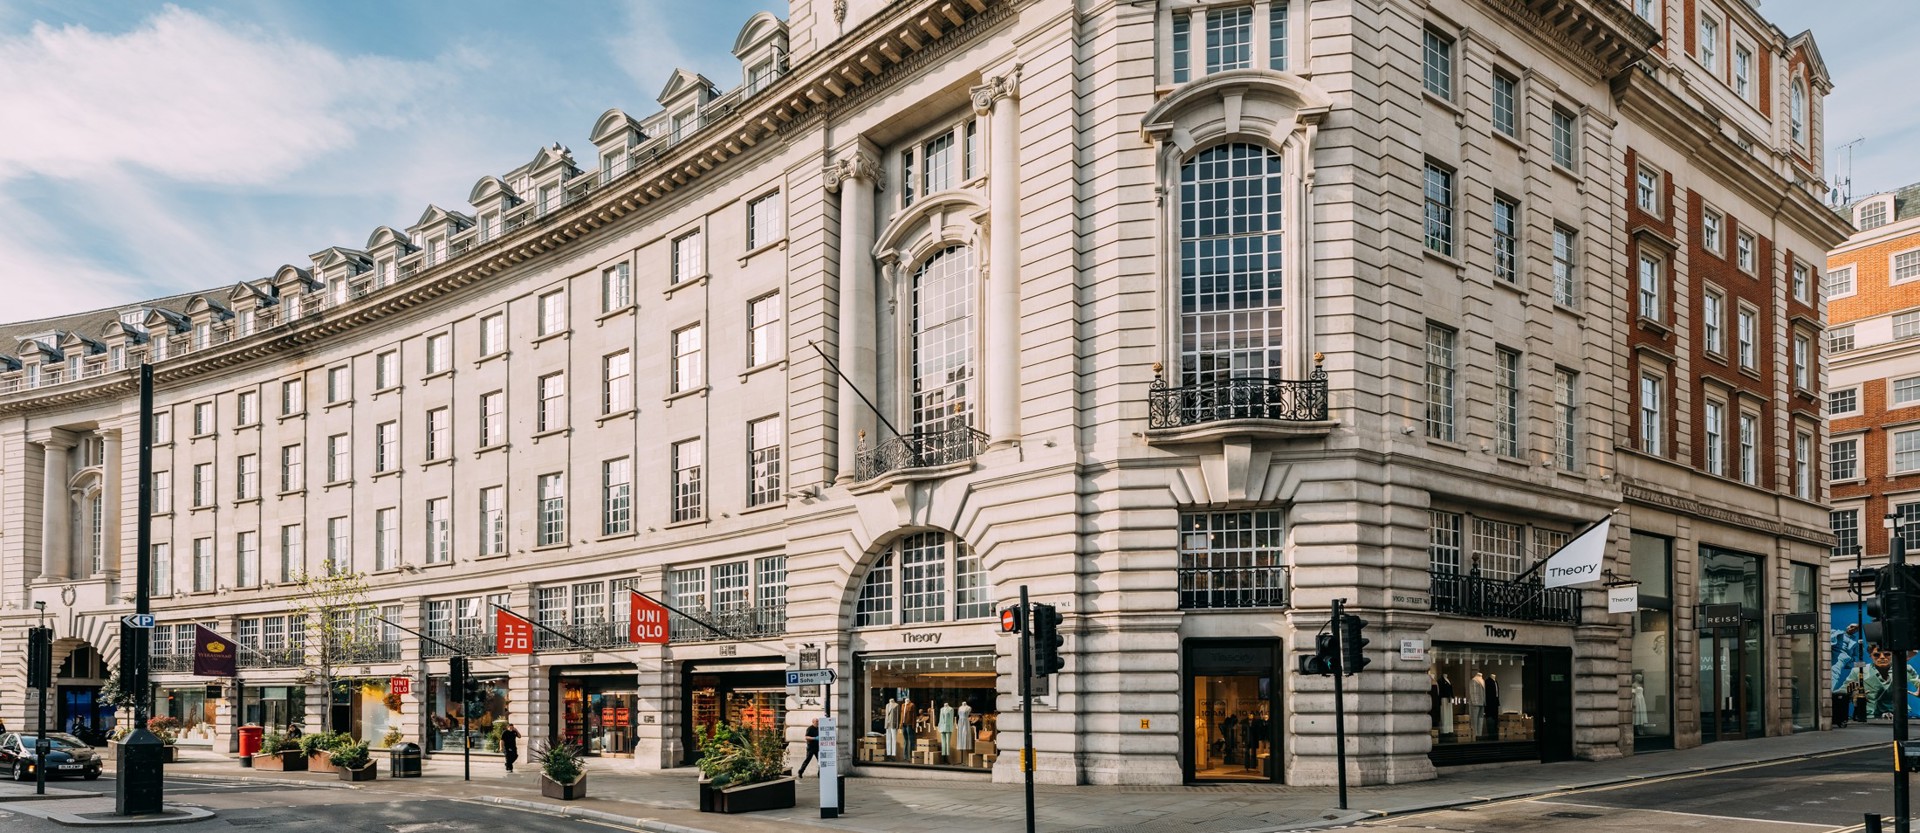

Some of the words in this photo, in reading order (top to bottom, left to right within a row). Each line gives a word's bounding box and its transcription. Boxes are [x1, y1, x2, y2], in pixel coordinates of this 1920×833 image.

[1549, 563, 1598, 578] Theory
[1392, 595, 1404, 603] VIGO
[1406, 596, 1423, 605] STREET
[1610, 596, 1635, 604] Theory
[141, 616, 152, 626] P
[636, 609, 661, 623] UNI
[1707, 615, 1738, 624] REISS
[636, 623, 663, 639] QLO
[1483, 624, 1517, 640] Theory
[1786, 623, 1816, 631] REISS
[900, 632, 943, 645] Theory
[790, 674, 797, 683] P
